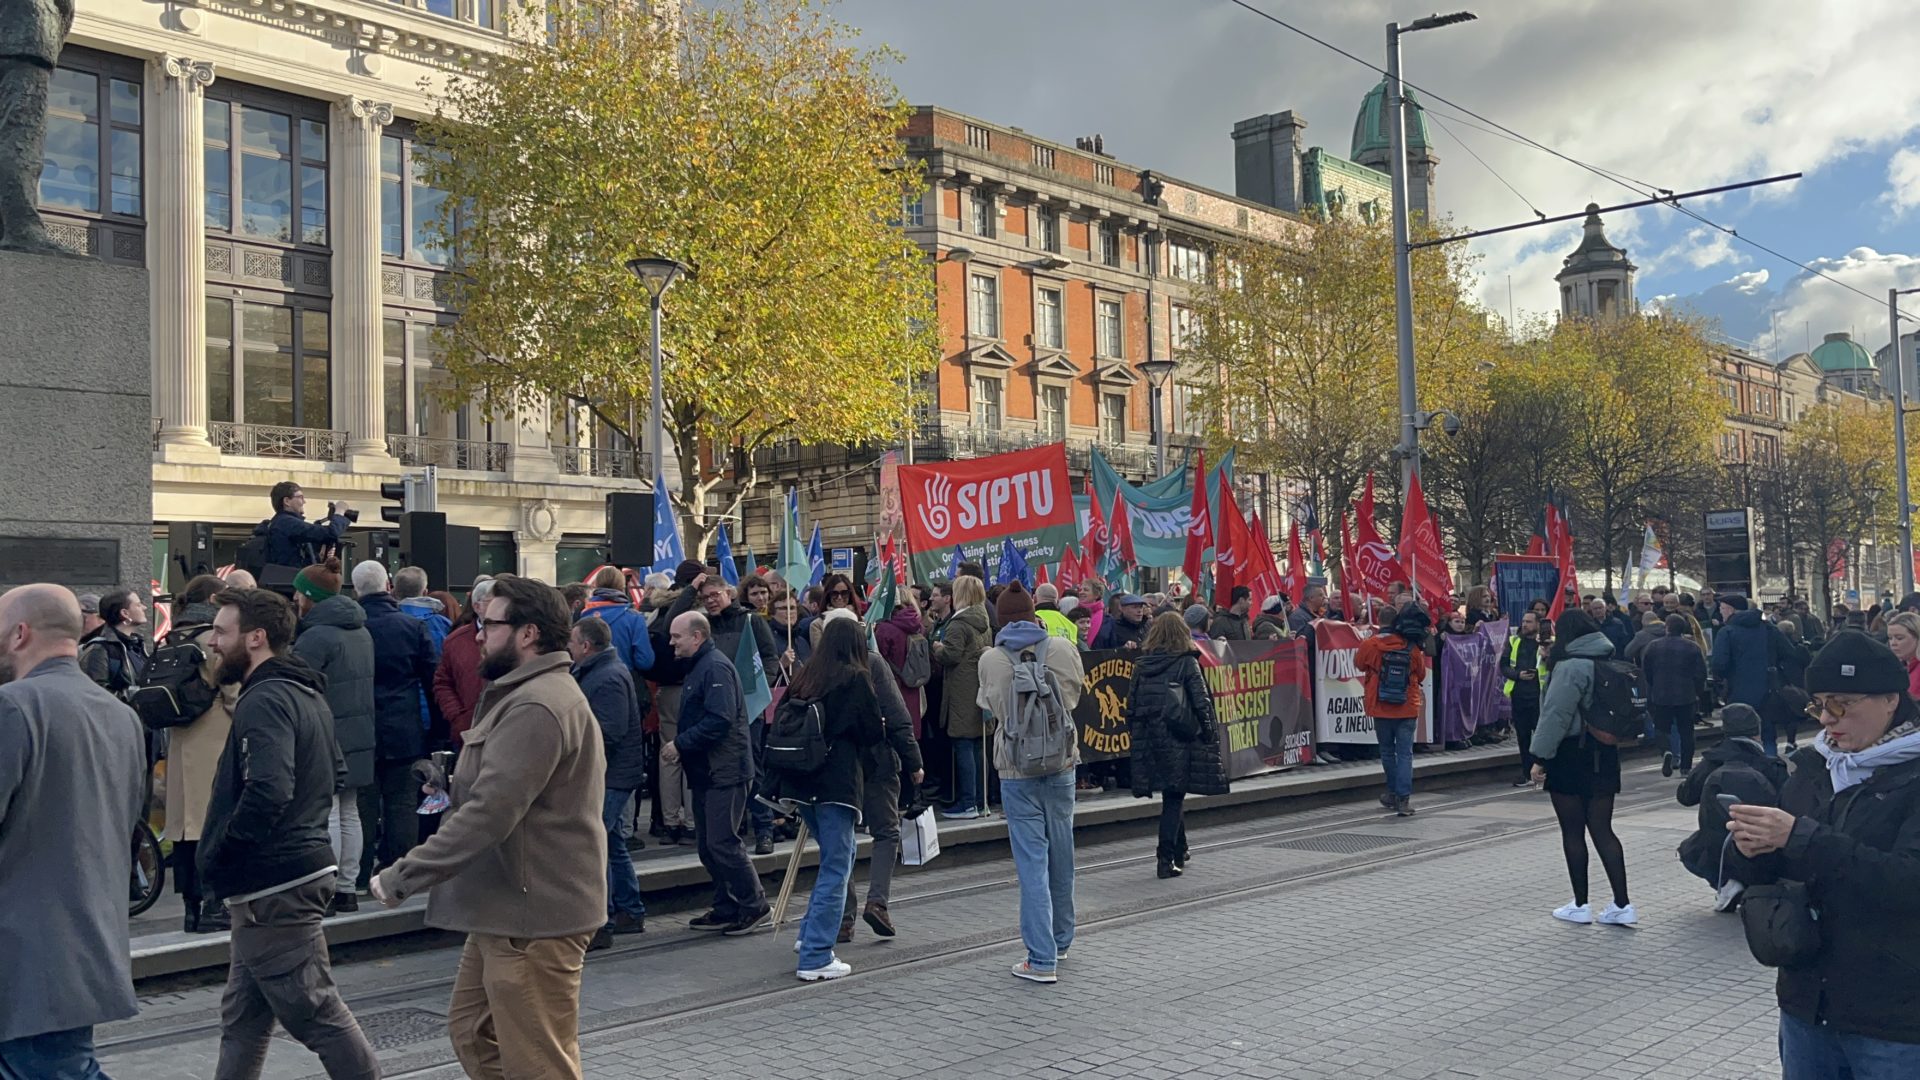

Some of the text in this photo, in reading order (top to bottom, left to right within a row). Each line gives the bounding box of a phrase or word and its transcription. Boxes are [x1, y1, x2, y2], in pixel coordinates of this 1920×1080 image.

[957, 469, 1053, 529] SIPTU
[986, 541, 1000, 553] for
[1001, 537, 1039, 549] Firness
[929, 571, 939, 579] at
[1082, 659, 1135, 695] REFUGE
[1238, 660, 1275, 690] FIGHT
[1334, 717, 1343, 733] &
